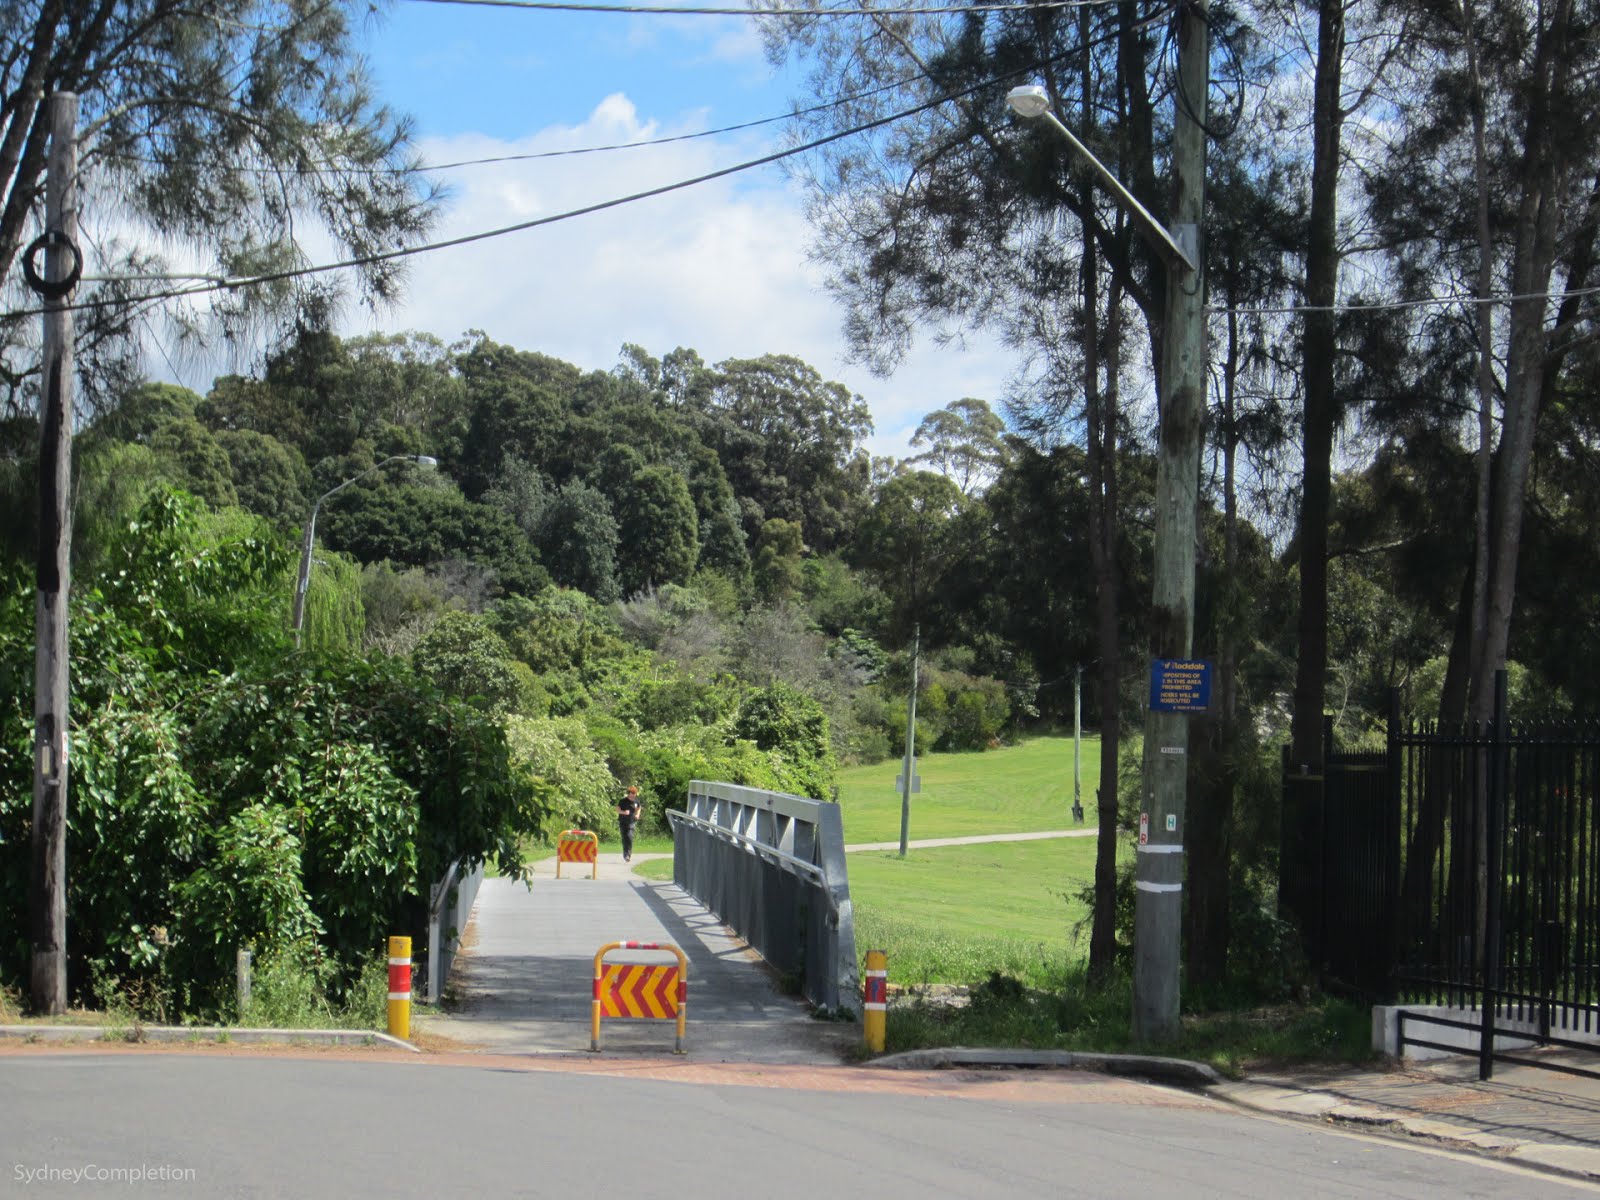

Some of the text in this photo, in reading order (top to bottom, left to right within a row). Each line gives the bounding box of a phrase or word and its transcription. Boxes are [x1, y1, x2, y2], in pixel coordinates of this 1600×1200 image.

[1141, 815, 1147, 824] H
[1168, 818, 1174, 828] H
[1141, 833, 1147, 843] R
